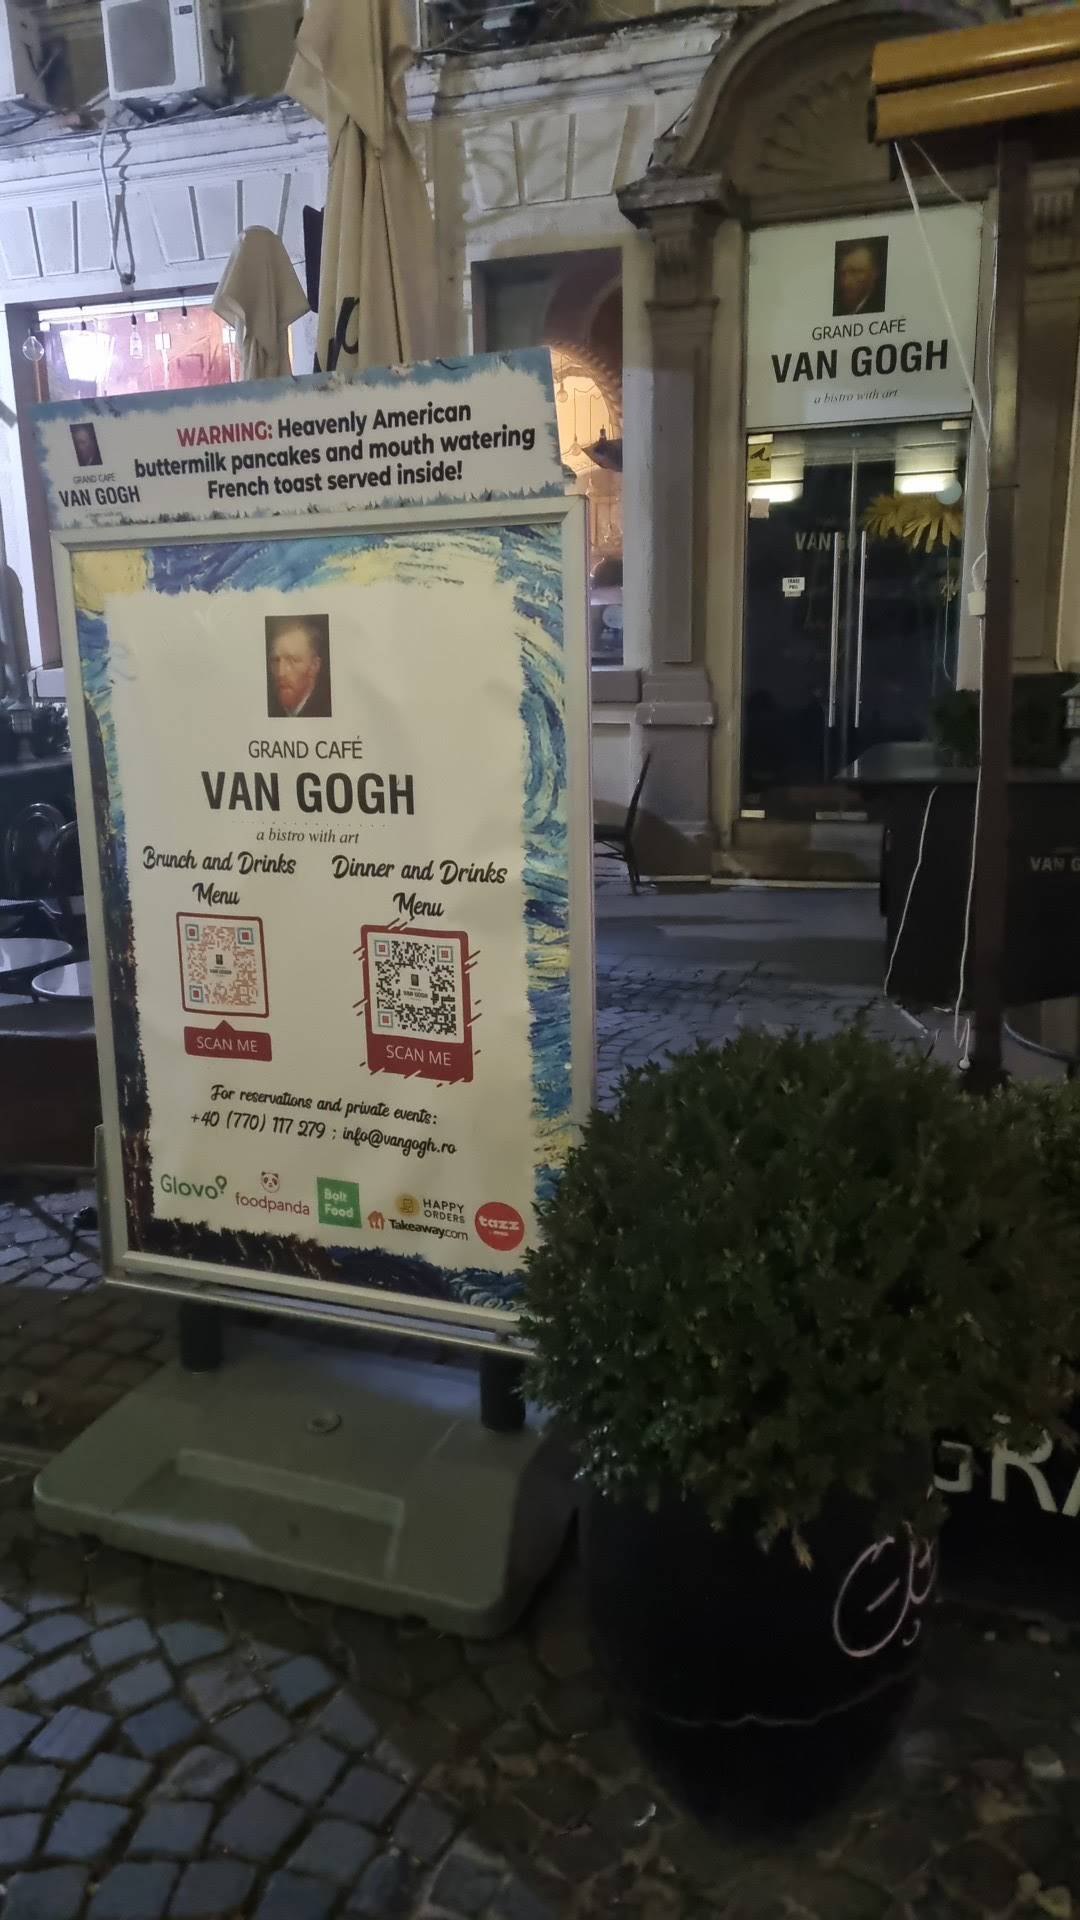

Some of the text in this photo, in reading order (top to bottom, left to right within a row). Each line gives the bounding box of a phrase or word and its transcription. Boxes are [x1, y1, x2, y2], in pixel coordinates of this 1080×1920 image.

[812, 322, 864, 341] GRAND
[771, 339, 948, 383] VAN GOGH
[814, 388, 898, 404] a bistro with art
[176, 401, 471, 447] WARNING: Heavenly American
[134, 424, 536, 478] buttermilk pancakes and mouth watering
[207, 460, 463, 499] French toast served inside!
[58, 485, 141, 508] VAN GOGH
[795, 531, 831, 551] VAN
[248, 735, 364, 760] GRAND CAFÉ
[201, 770, 415, 815] VAN GOGH
[256, 826, 360, 845] a bistro with art
[142, 845, 297, 875] Brunch and Drinks
[331, 854, 508, 885] Dinner and Drinks
[1029, 856, 1065, 872] VAN
[192, 882, 240, 906] Menu
[392, 892, 444, 917] Menu
[196, 1035, 259, 1053] SCAN ME
[385, 1044, 453, 1066] SCAN ME
[210, 1084, 438, 1125] For reservations and private events:
[190, 1110, 220, 1127] +40
[226, 1111, 266, 1132] (770)
[272, 1116, 294, 1135] 117
[297, 1120, 326, 1139] 279
[342, 1126, 457, 1159] info@vangogh.ro
[160, 1174, 228, 1200] Glovo
[324, 1188, 348, 1203] Bolt
[235, 1192, 311, 1216] foodpanda
[324, 1204, 354, 1218] Food
[422, 1199, 465, 1214] HAPPY
[423, 1209, 466, 1224] ORDERS
[478, 1215, 520, 1231] tazz
[388, 1218, 469, 1241] Takeaway.com
